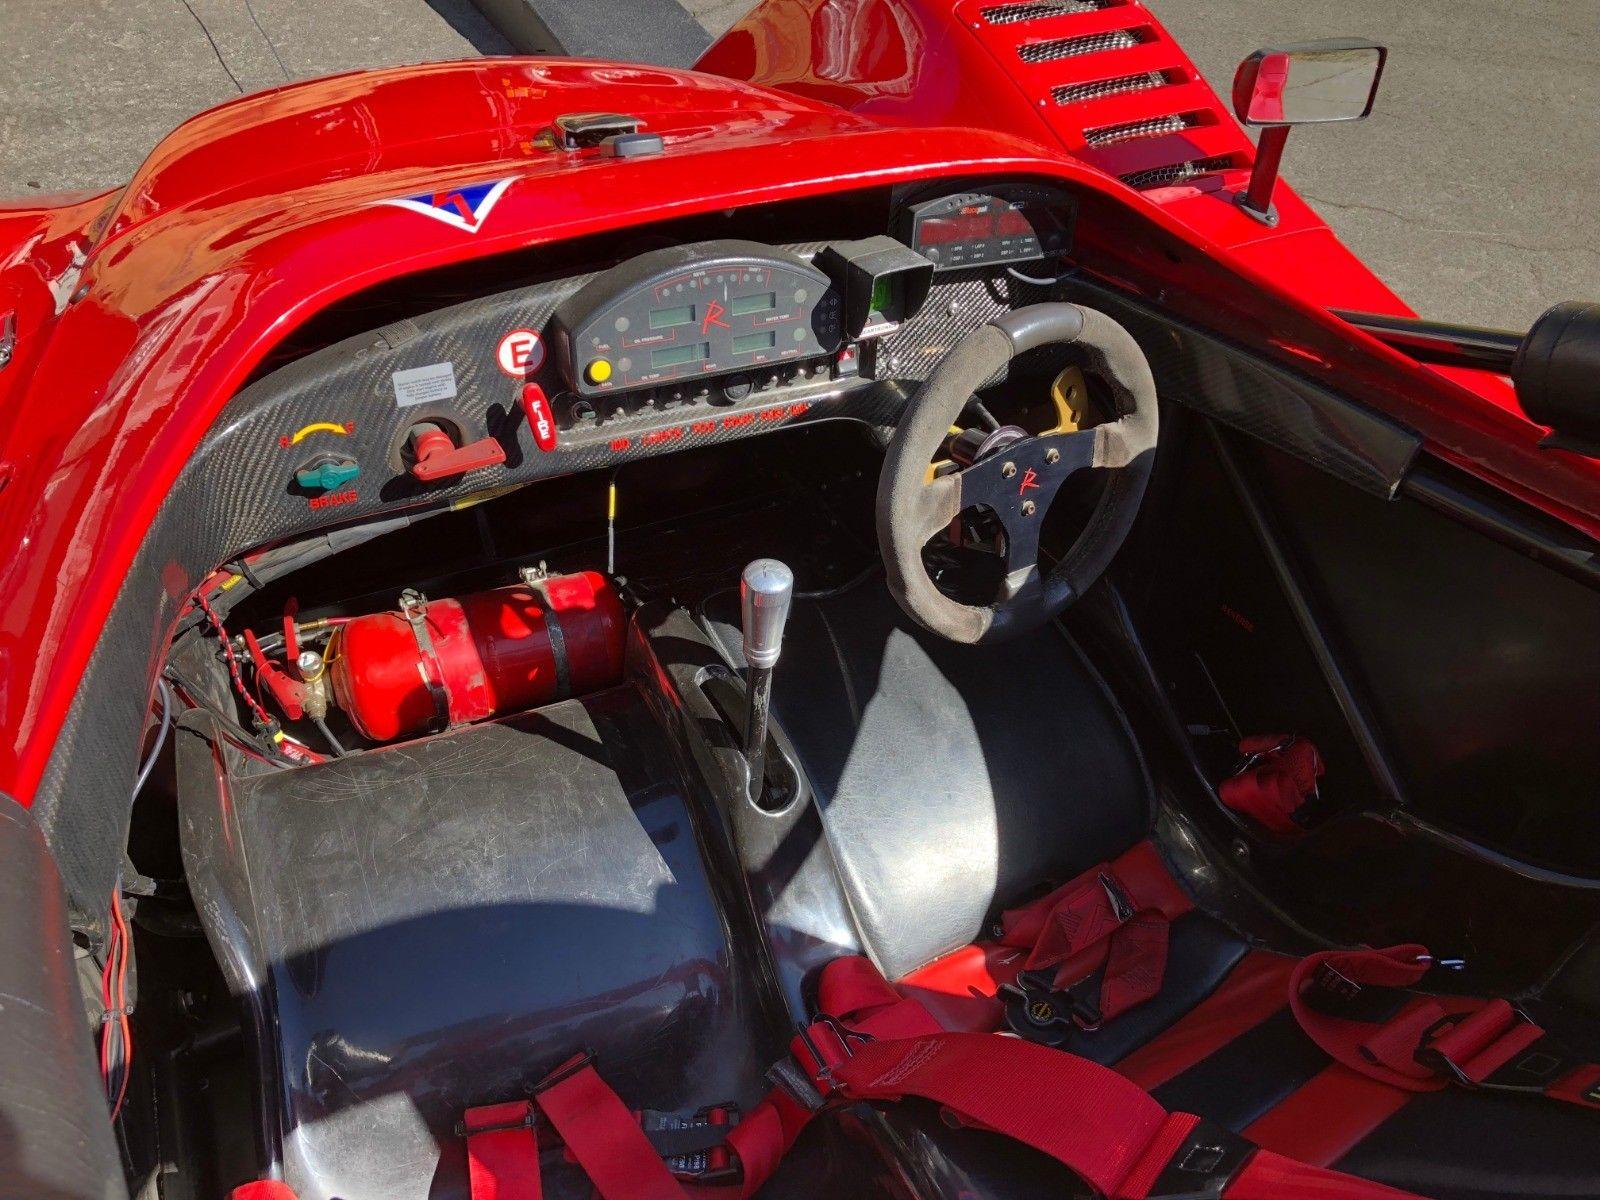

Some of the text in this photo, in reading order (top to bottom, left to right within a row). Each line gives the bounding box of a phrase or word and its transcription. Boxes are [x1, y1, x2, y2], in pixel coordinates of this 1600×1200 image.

[702, 299, 732, 335] R
[510, 339, 533, 369] E
[308, 488, 358, 512] BRAKE
